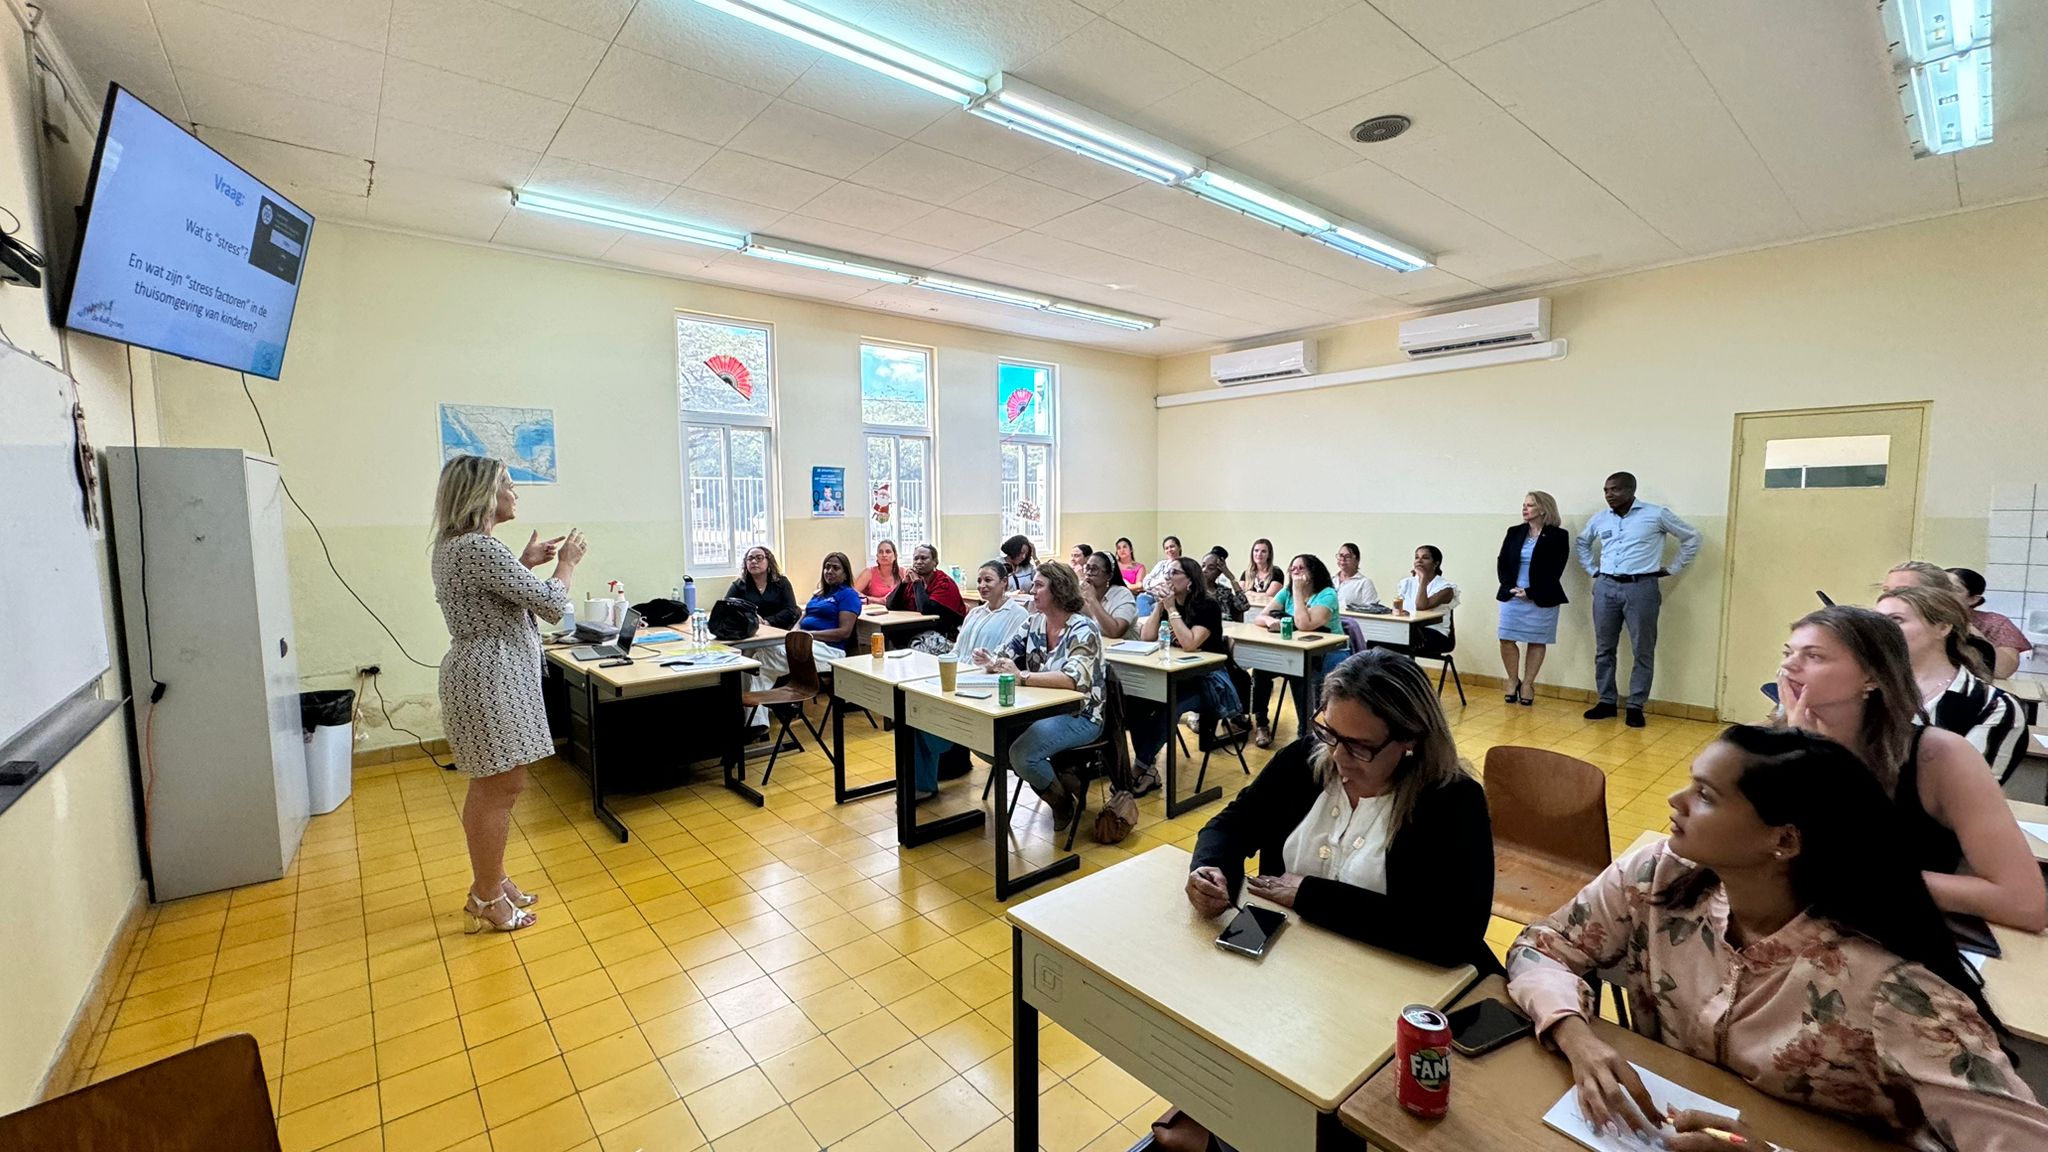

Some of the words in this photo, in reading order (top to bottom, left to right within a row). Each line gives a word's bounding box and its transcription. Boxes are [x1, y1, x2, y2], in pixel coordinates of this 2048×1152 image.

[214, 174, 246, 207] Vraag:
[186, 218, 203, 239] Wat
[205, 227, 212, 242] is
[128, 252, 143, 270] En
[145, 261, 163, 278] wat
[165, 269, 182, 286] zijn
[251, 301, 257, 314] in
[258, 304, 267, 318] de
[134, 281, 203, 318] thuisomgeving
[205, 308, 219, 321] van
[221, 311, 257, 334] kinderen?
